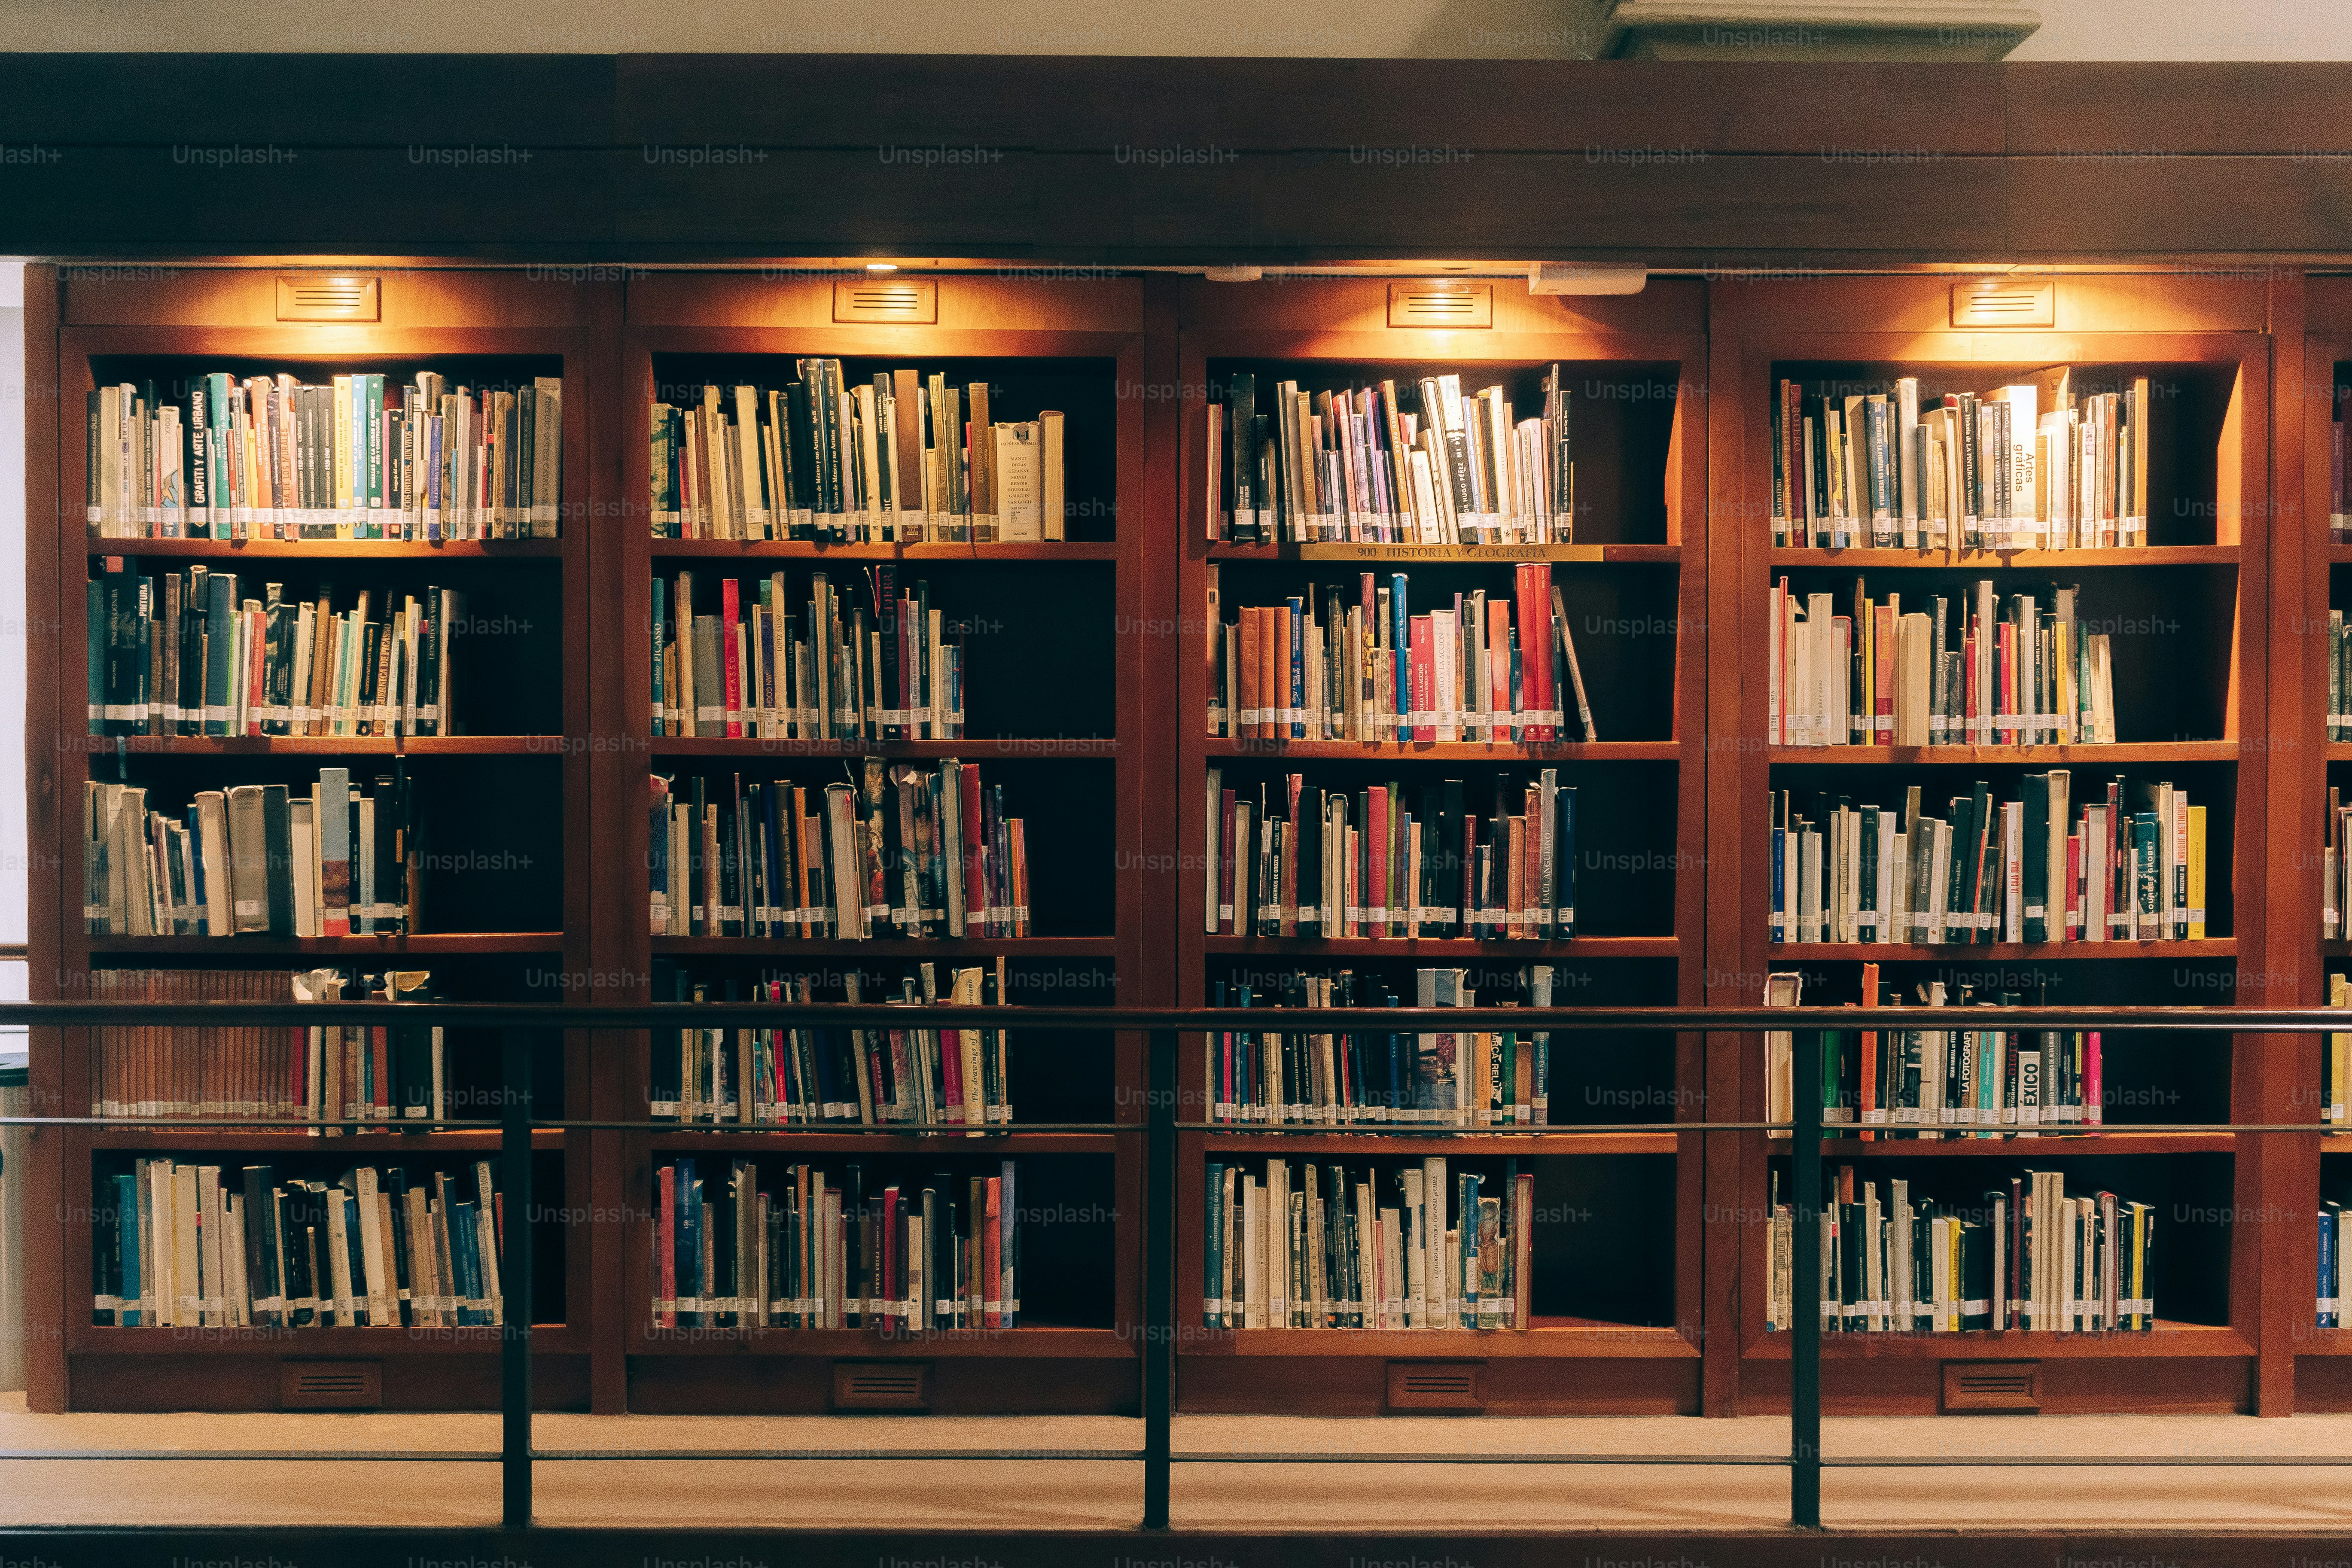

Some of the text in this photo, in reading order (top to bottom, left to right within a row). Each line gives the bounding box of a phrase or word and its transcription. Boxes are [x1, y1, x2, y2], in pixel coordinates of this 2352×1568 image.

[192, 391, 203, 429] URBANO
[1389, 402, 1397, 428] CARMEN
[1793, 407, 1801, 451] BOTERO
[193, 432, 204, 456] ARTE
[281, 428, 289, 462] MURALES
[1456, 448, 1462, 457] MI
[1965, 444, 1971, 452] LA
[2013, 445, 2023, 491] gráficas
[2024, 454, 2034, 483] Artes
[194, 468, 204, 503] GRAFITI
[2005, 490, 2010, 499] DE
[1357, 545, 1546, 558] 900 HISTORIA Y GEOGRAFÍA
[139, 585, 148, 616] PINTURA
[430, 615, 436, 623] DA
[381, 624, 392, 654] PICASSO
[380, 656, 390, 666] DE
[1438, 661, 1444, 669] LA
[1542, 832, 1551, 903] RAÚL ANGUIANO
[2011, 862, 2019, 874] ROJA
[2011, 874, 2019, 887] CAJA
[970, 1037, 977, 1045] of
[970, 1048, 978, 1084] drawings
[2008, 1034, 2018, 1075] DIGITA
[1962, 1081, 1971, 1092] LA
[2020, 1063, 2038, 1106] ÉXICO
